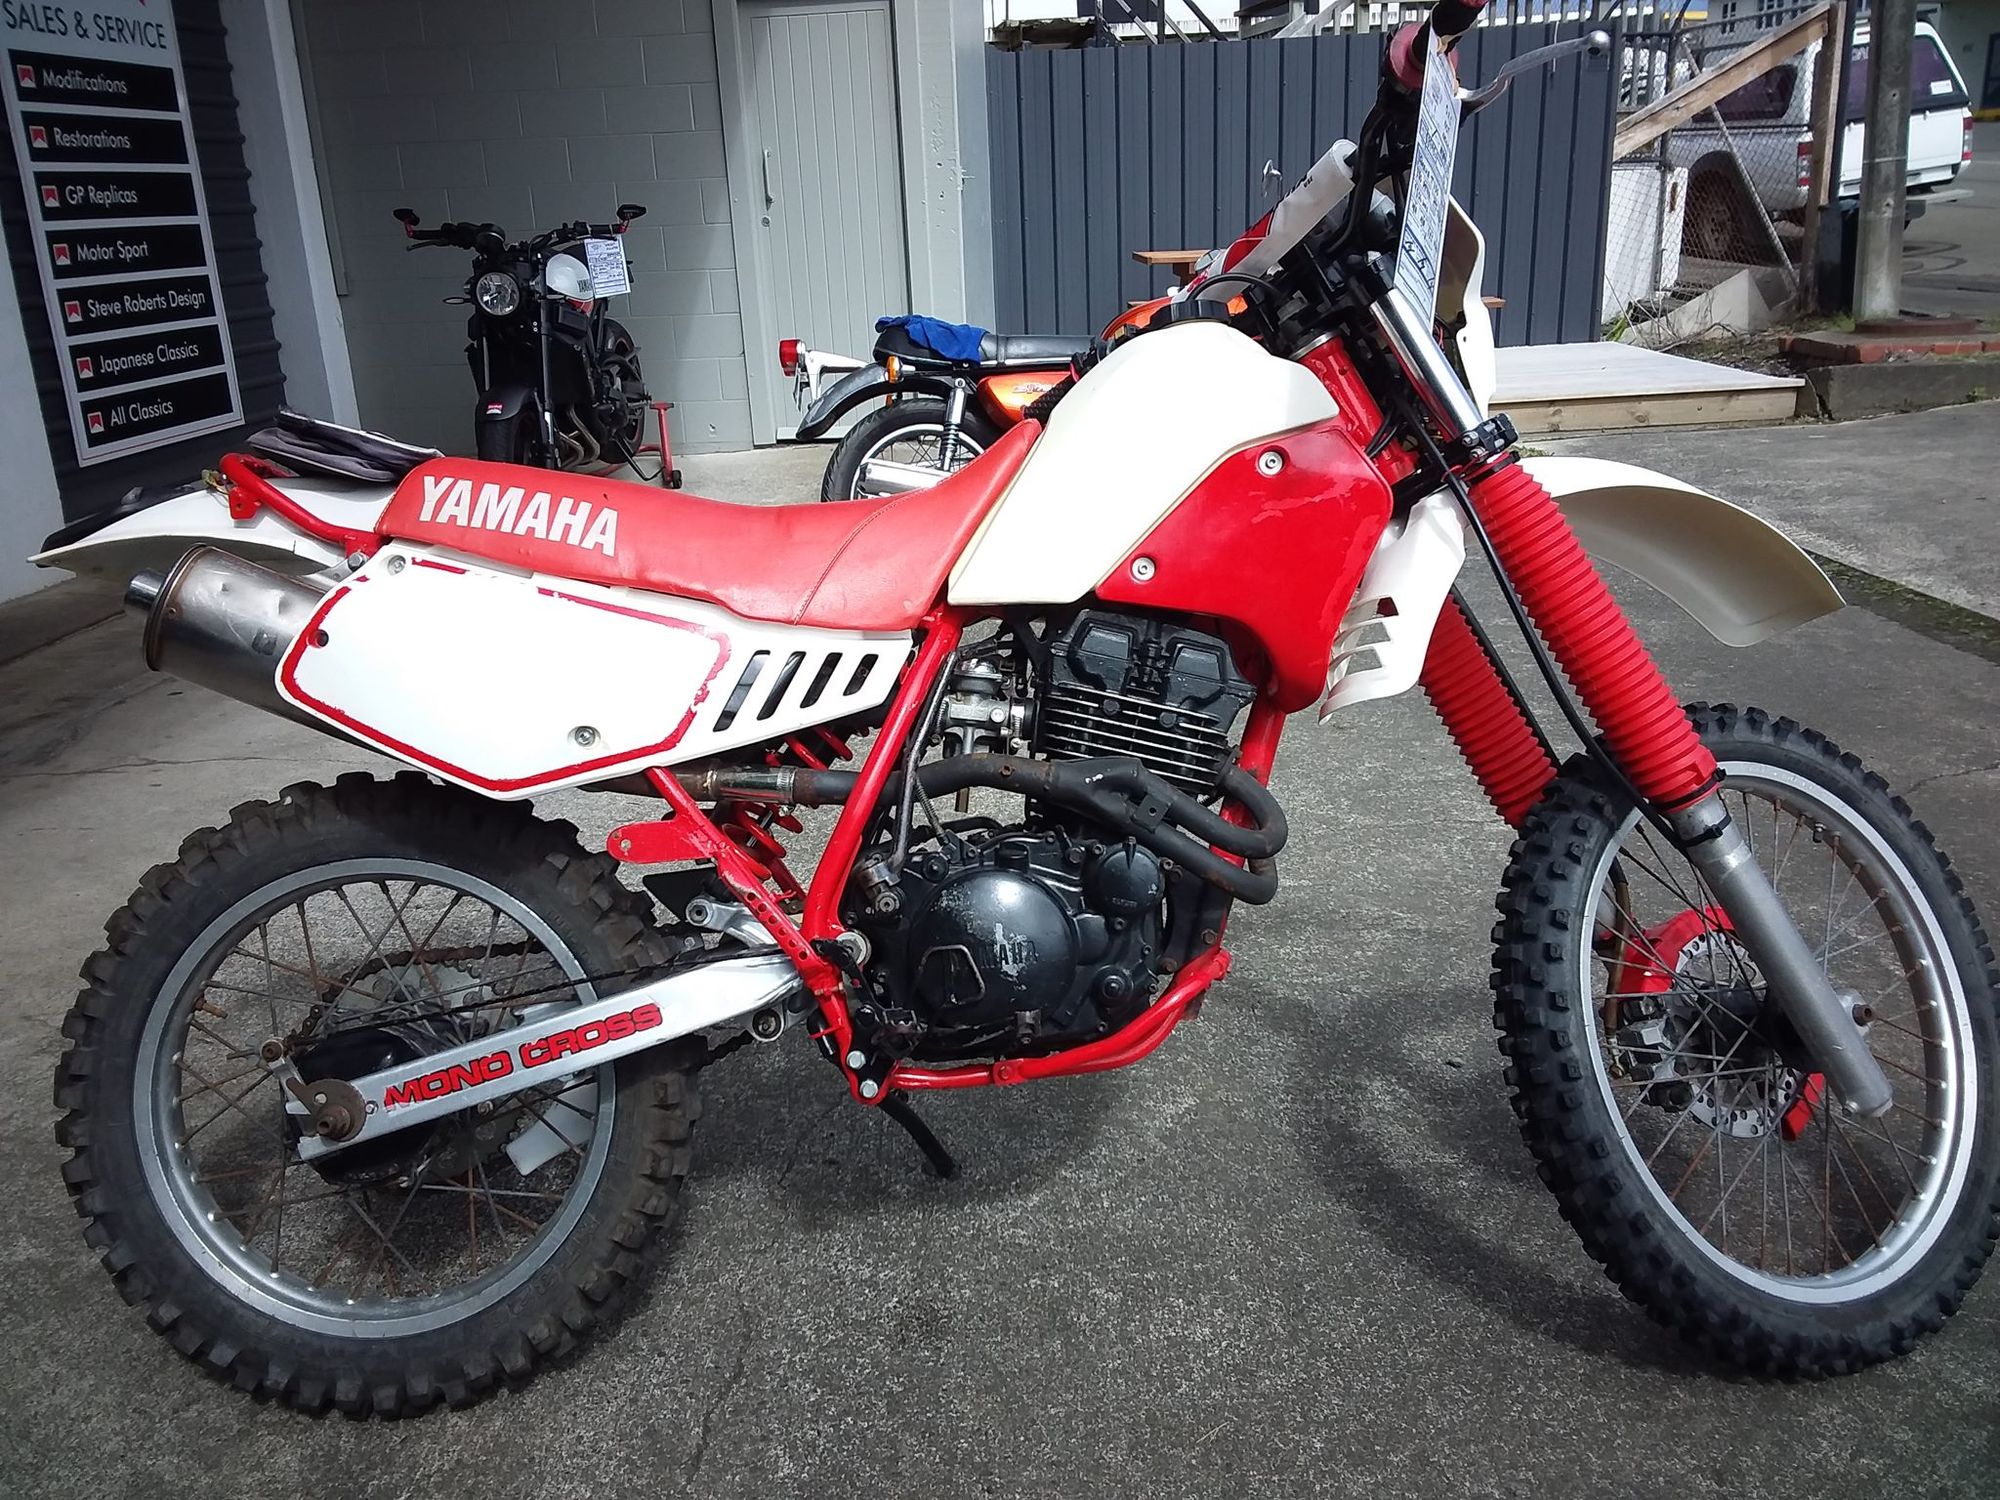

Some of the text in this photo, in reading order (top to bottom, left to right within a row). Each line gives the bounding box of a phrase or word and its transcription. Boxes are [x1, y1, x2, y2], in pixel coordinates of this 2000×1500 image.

[2, 0, 167, 49] SALES & SERVICE
[42, 68, 128, 94] Modifications
[53, 127, 131, 149] Restorations
[65, 185, 138, 208] GP Replicas
[77, 240, 149, 263] Motor Sport
[87, 288, 206, 318] Steve Roberts Design
[100, 341, 199, 376] Japanese Classics
[110, 398, 174, 427] All Classics
[419, 475, 618, 557] YAMAHA
[384, 1003, 663, 1109] MONO CROSS
